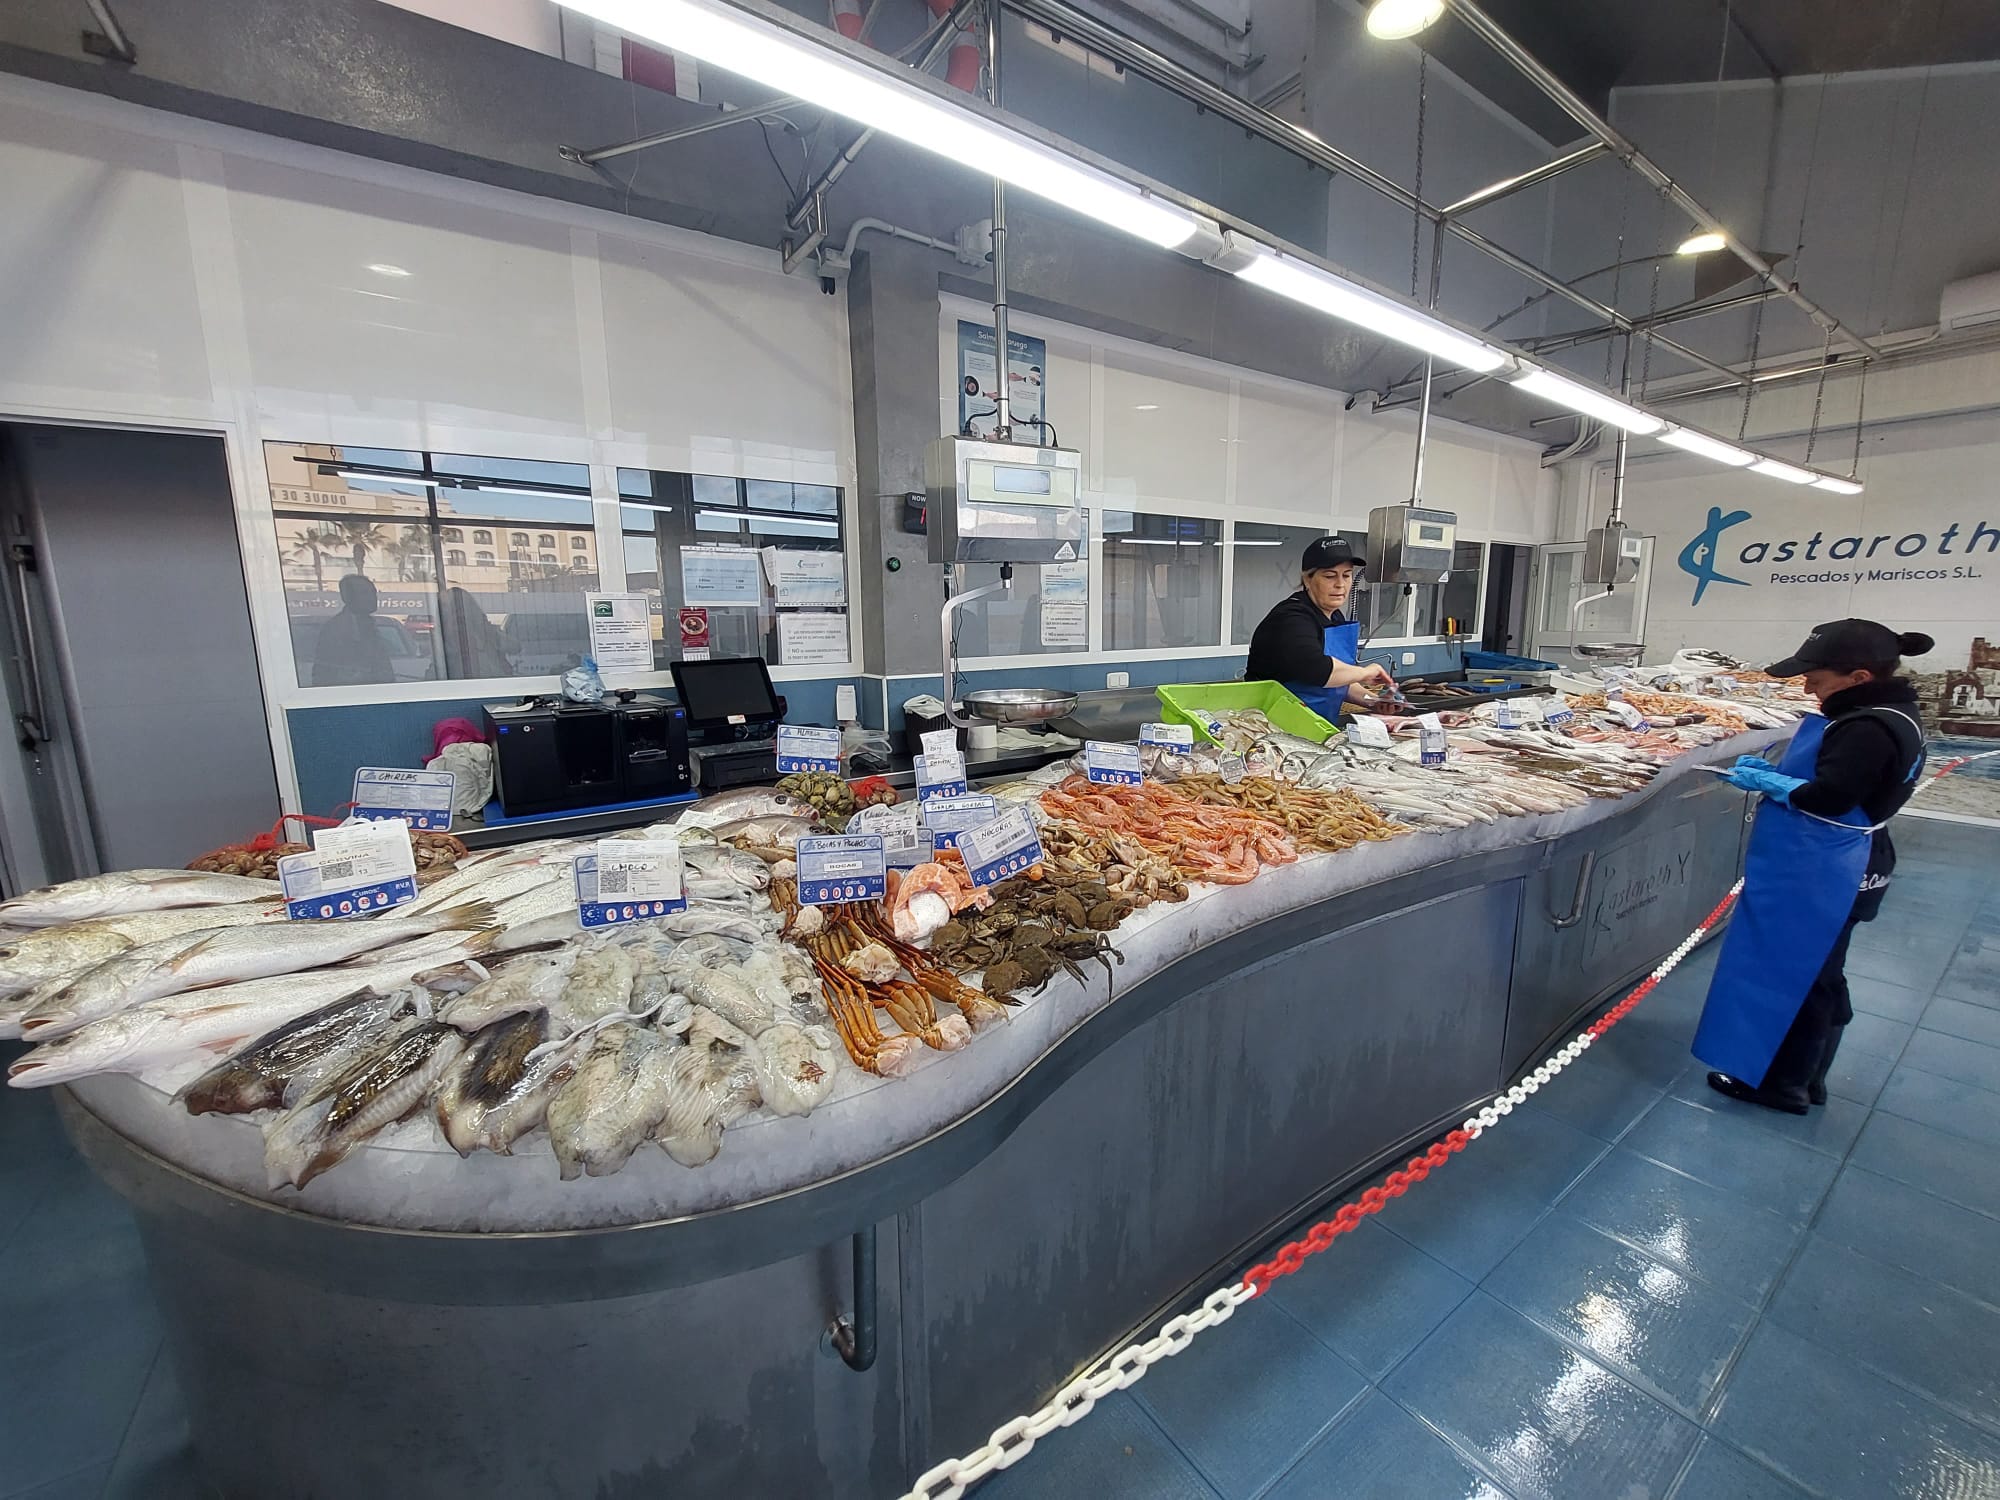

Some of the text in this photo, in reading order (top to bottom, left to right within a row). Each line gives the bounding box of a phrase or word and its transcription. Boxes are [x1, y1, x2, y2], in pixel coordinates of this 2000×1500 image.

[1770, 566, 1982, 585] Pescados y Mariscos S.L.
[377, 597, 424, 608] riscos
[378, 772, 418, 782] CHIRLAS
